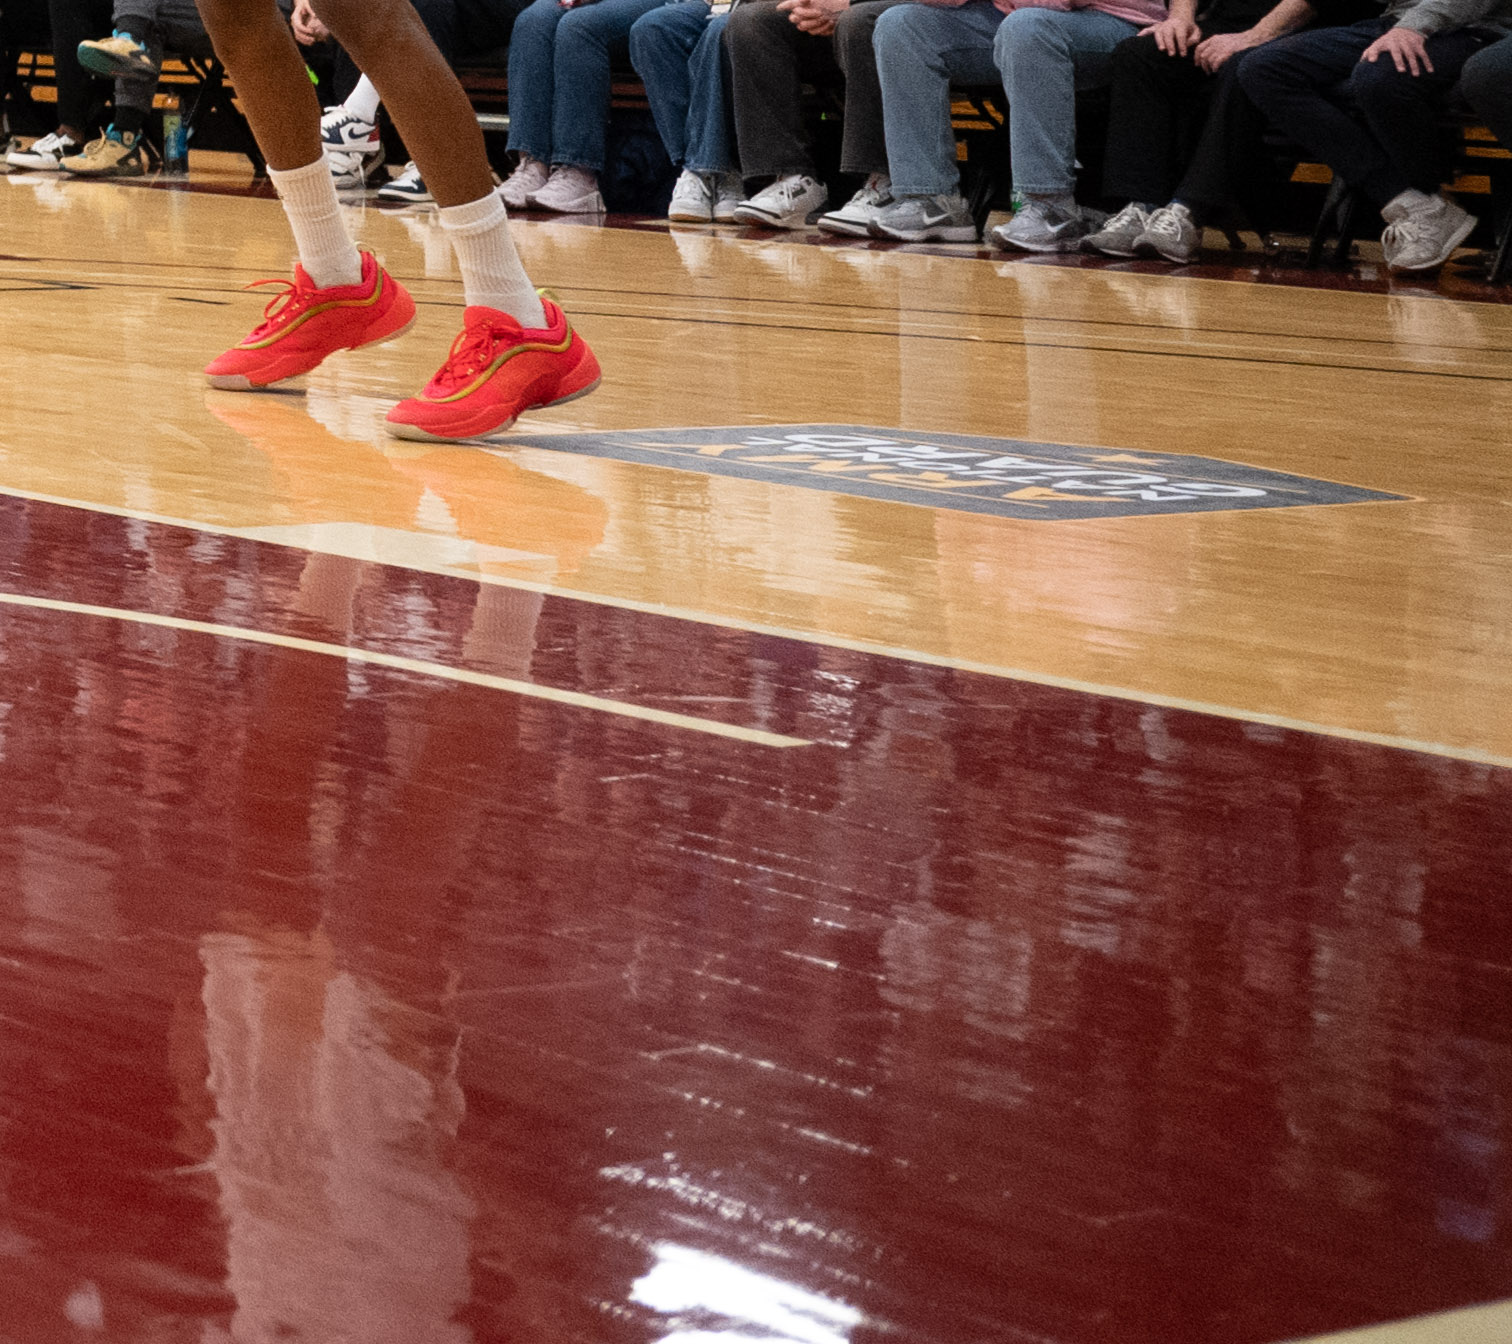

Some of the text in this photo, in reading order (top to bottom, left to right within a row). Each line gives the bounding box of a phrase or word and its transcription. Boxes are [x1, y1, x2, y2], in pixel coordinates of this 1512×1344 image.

[634, 442, 1134, 502] ARMY
[739, 436, 1199, 502] NATIONAL
[784, 433, 1269, 498] GUARD
